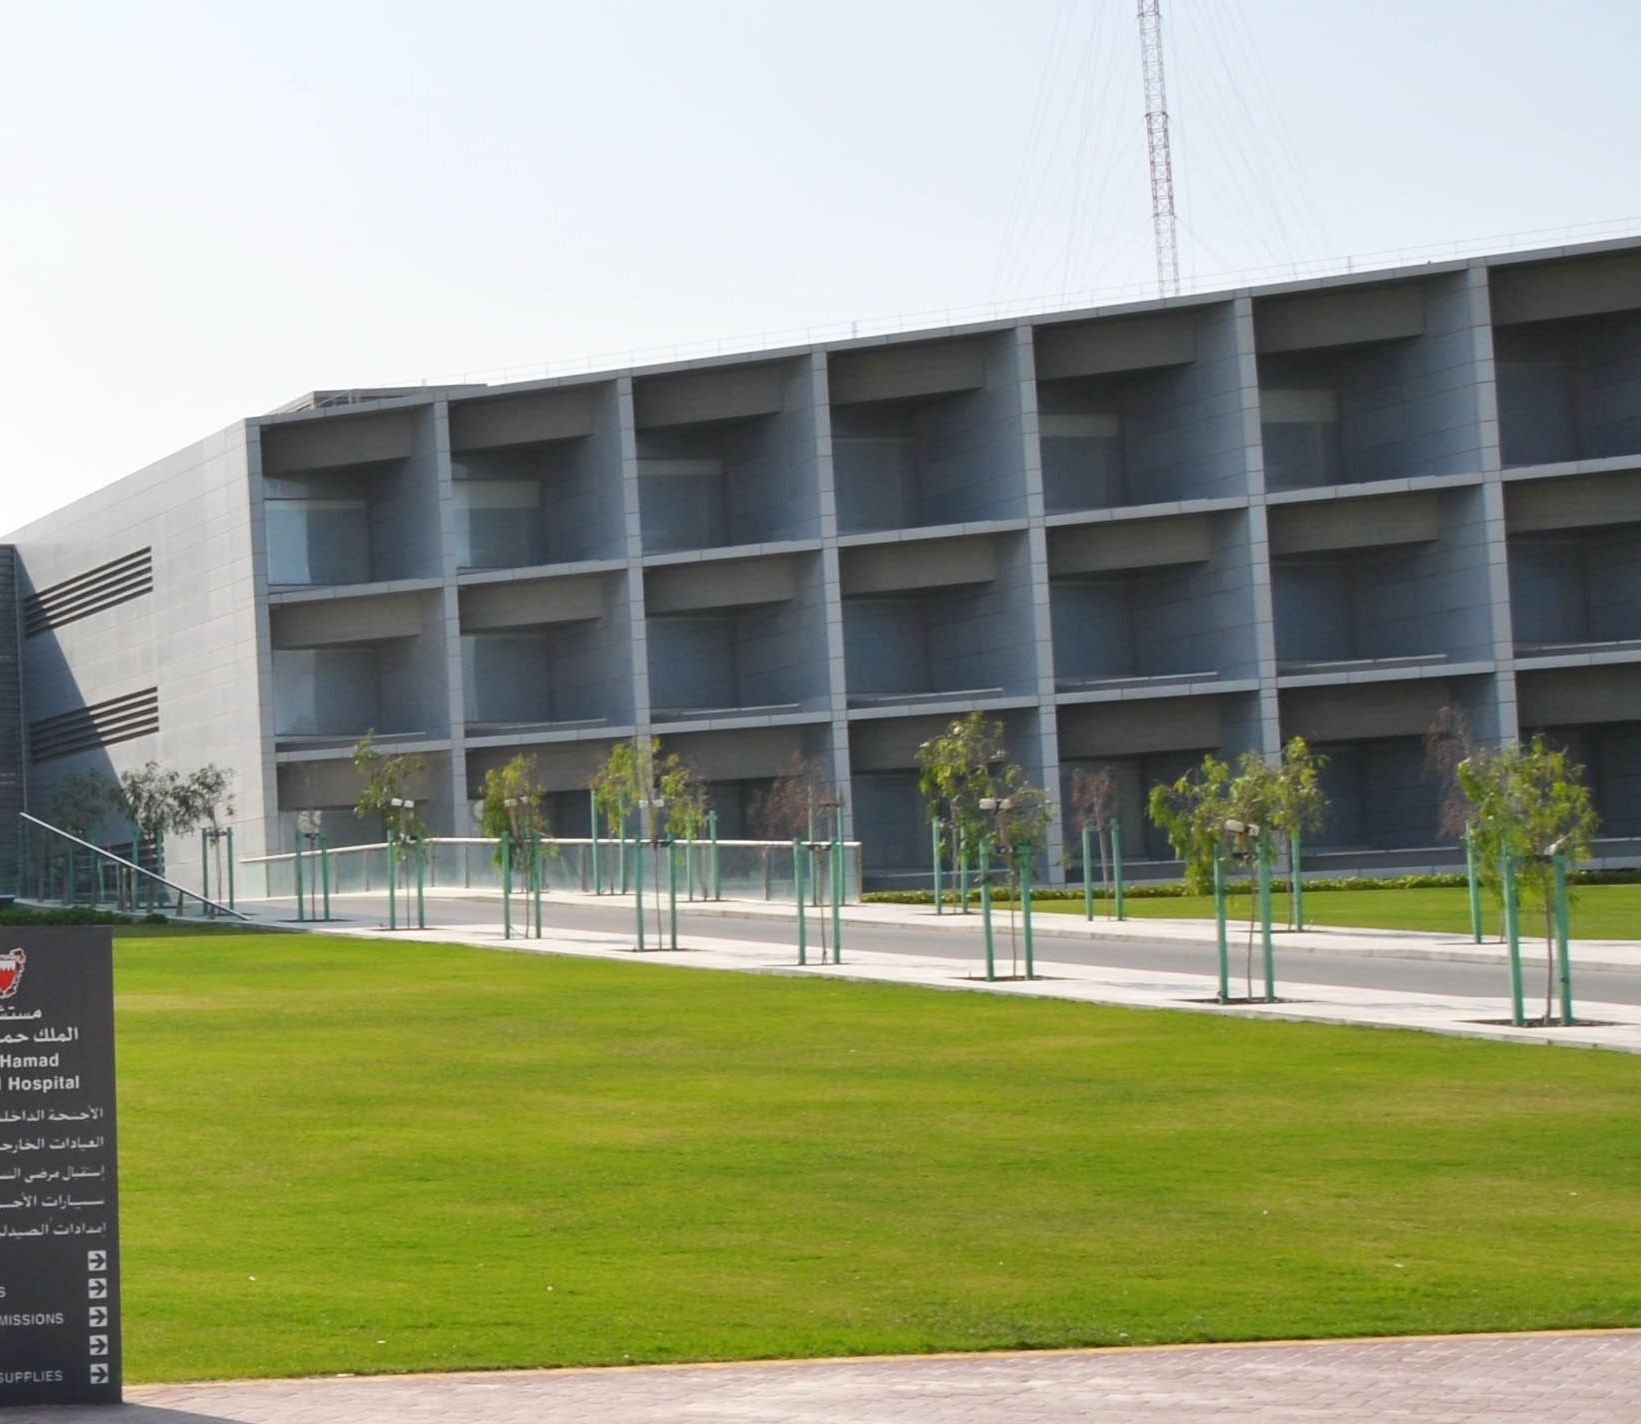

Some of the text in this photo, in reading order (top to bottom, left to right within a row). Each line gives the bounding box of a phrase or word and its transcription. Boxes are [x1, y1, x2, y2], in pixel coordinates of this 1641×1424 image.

[33, 1027, 79, 1043] الملك
[0, 1053, 60, 1068] Hamad
[8, 1075, 80, 1093] Hospital
